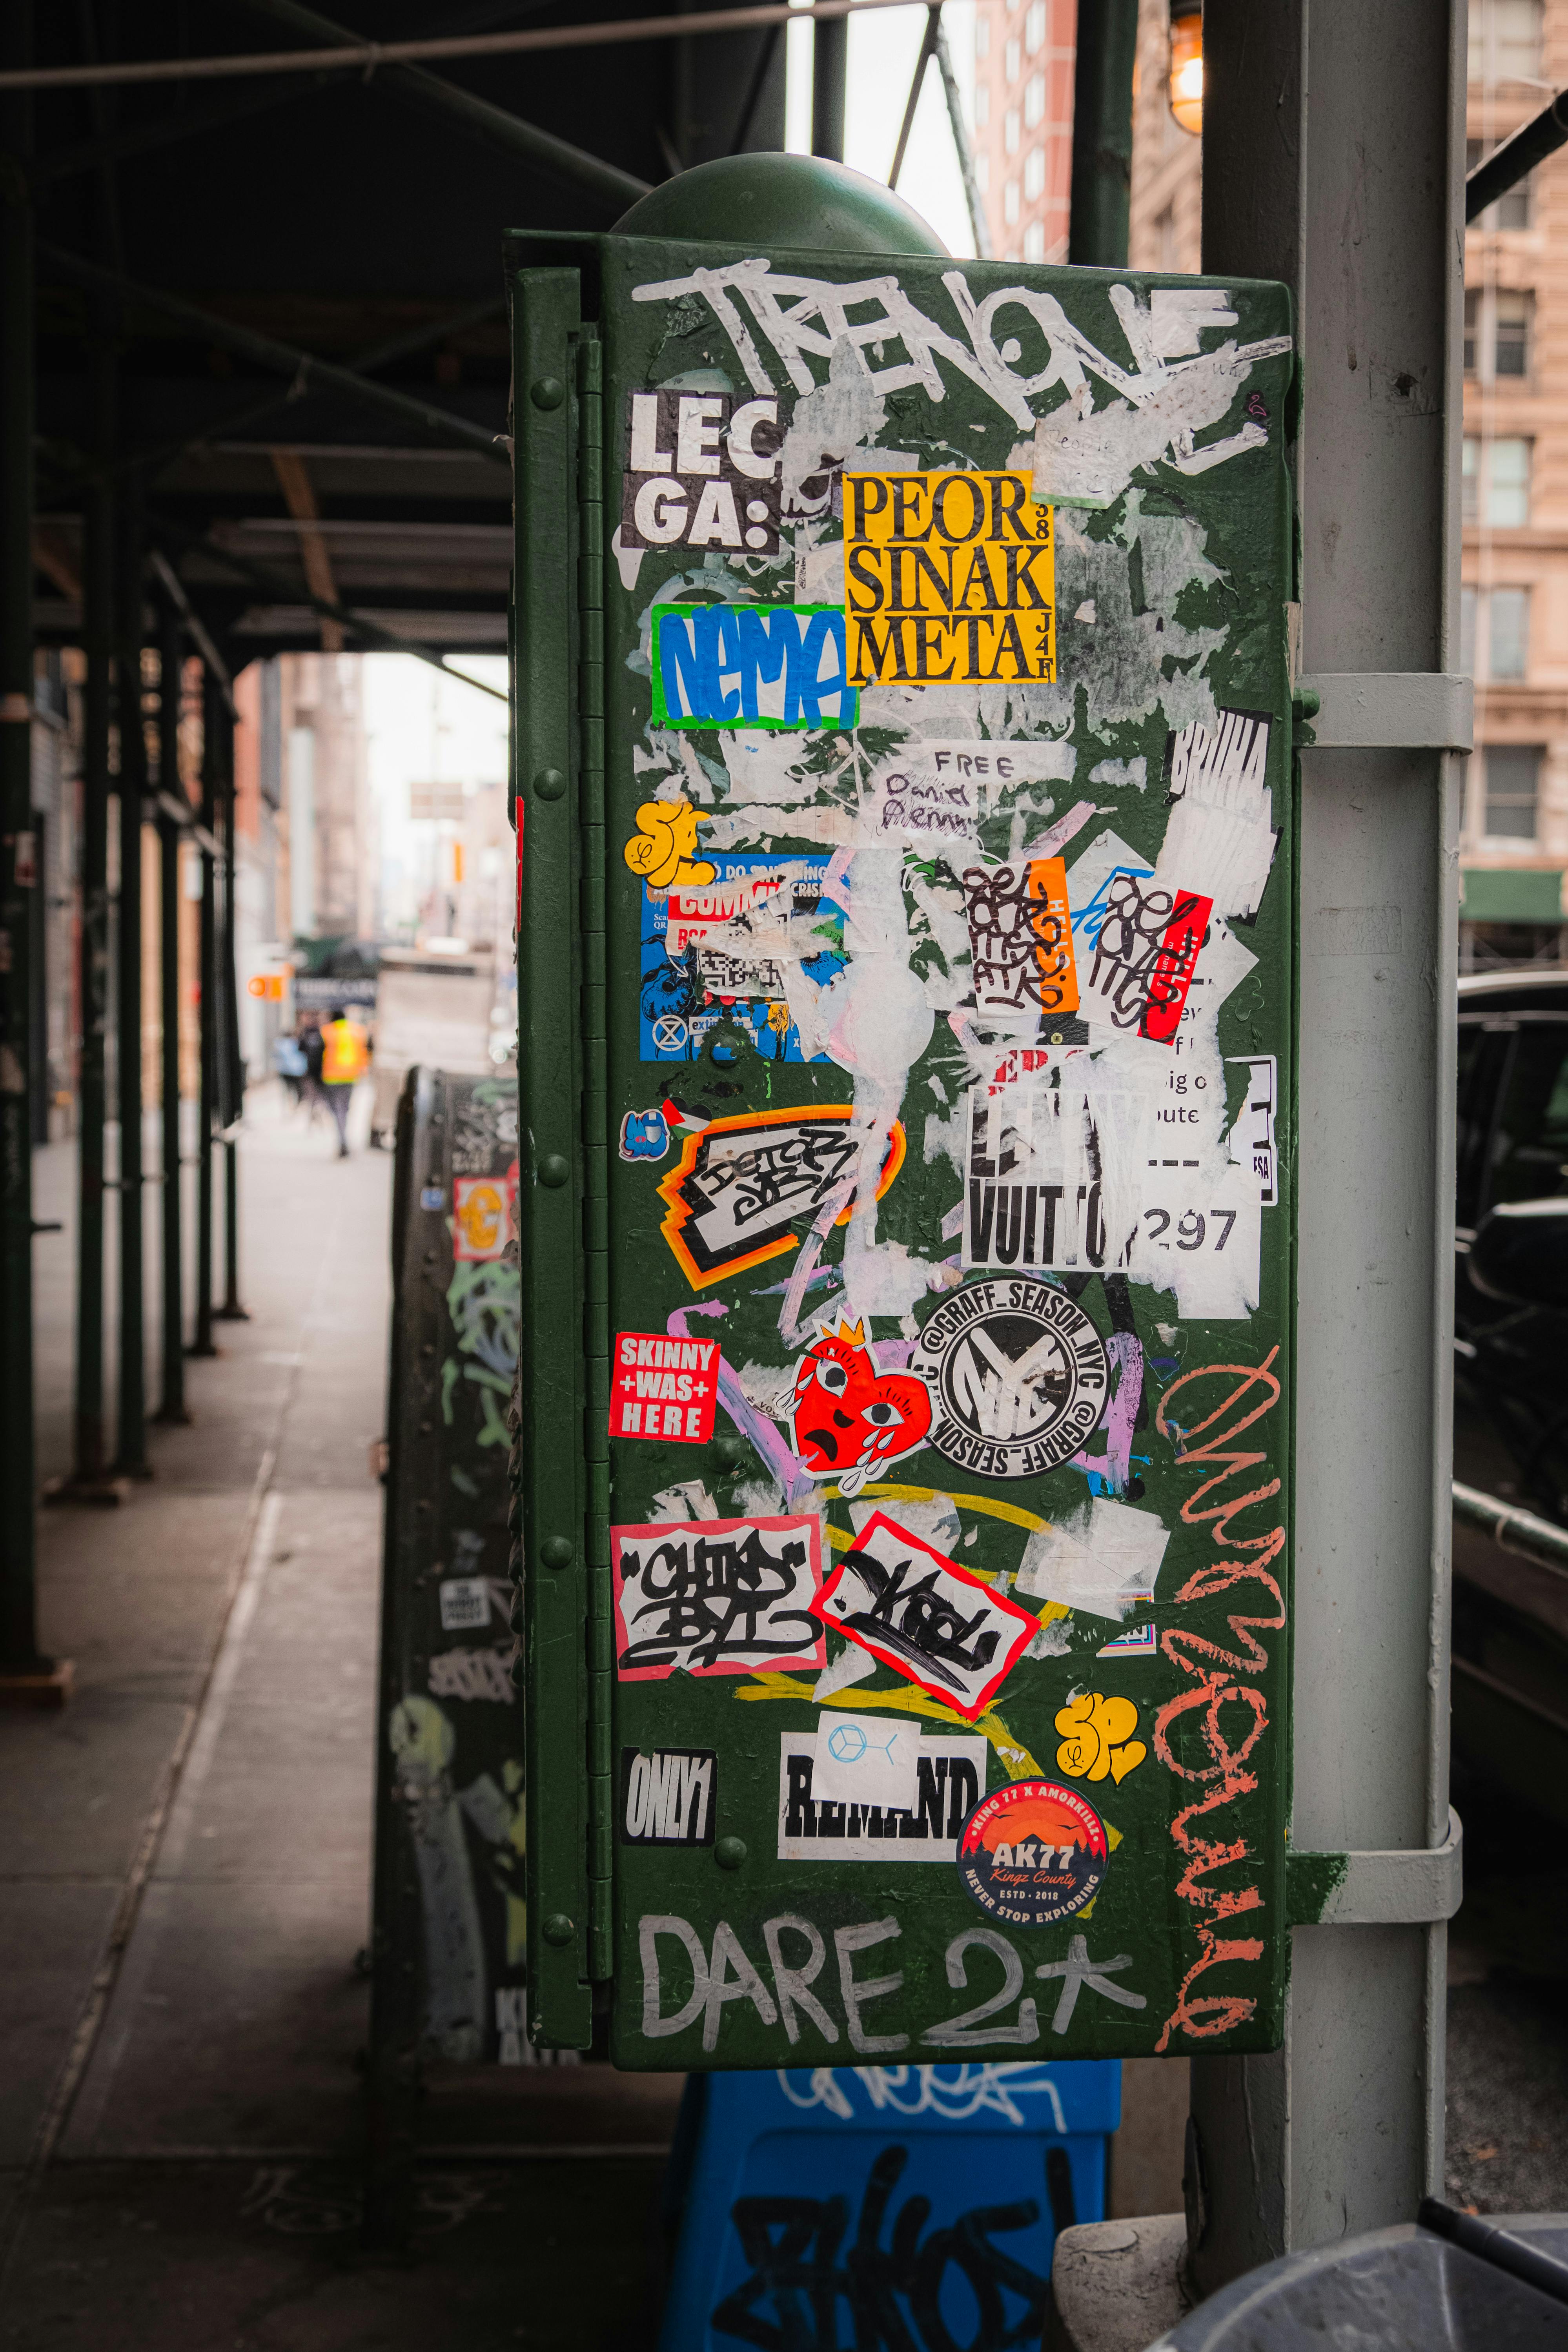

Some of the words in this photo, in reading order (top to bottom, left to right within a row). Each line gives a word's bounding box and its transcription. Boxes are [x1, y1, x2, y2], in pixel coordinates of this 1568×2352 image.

[847, 475, 1036, 543] PEOR
[848, 544, 1052, 614] SINAK
[850, 612, 1036, 681] META
[935, 751, 1014, 778] FREE
[654, 922, 667, 930] QR
[621, 1338, 715, 1371] SKINNY
[621, 1402, 702, 1437] HERE
[972, 1800, 1000, 1830] KING
[1002, 1787, 1018, 1802] 77
[1023, 1786, 1033, 1796] X
[991, 1843, 1075, 1870] AK77
[965, 1868, 996, 1909] NEVER
[996, 1905, 1031, 1923] STOP
[1036, 1874, 1100, 1923] EXPLORING
[989, 1868, 1029, 1887] Kingz
[1033, 1870, 1077, 1889] County
[1000, 1889, 1026, 1900] ESTD
[1035, 1891, 1059, 1901] 2018
[638, 1912, 911, 2053] DARE
